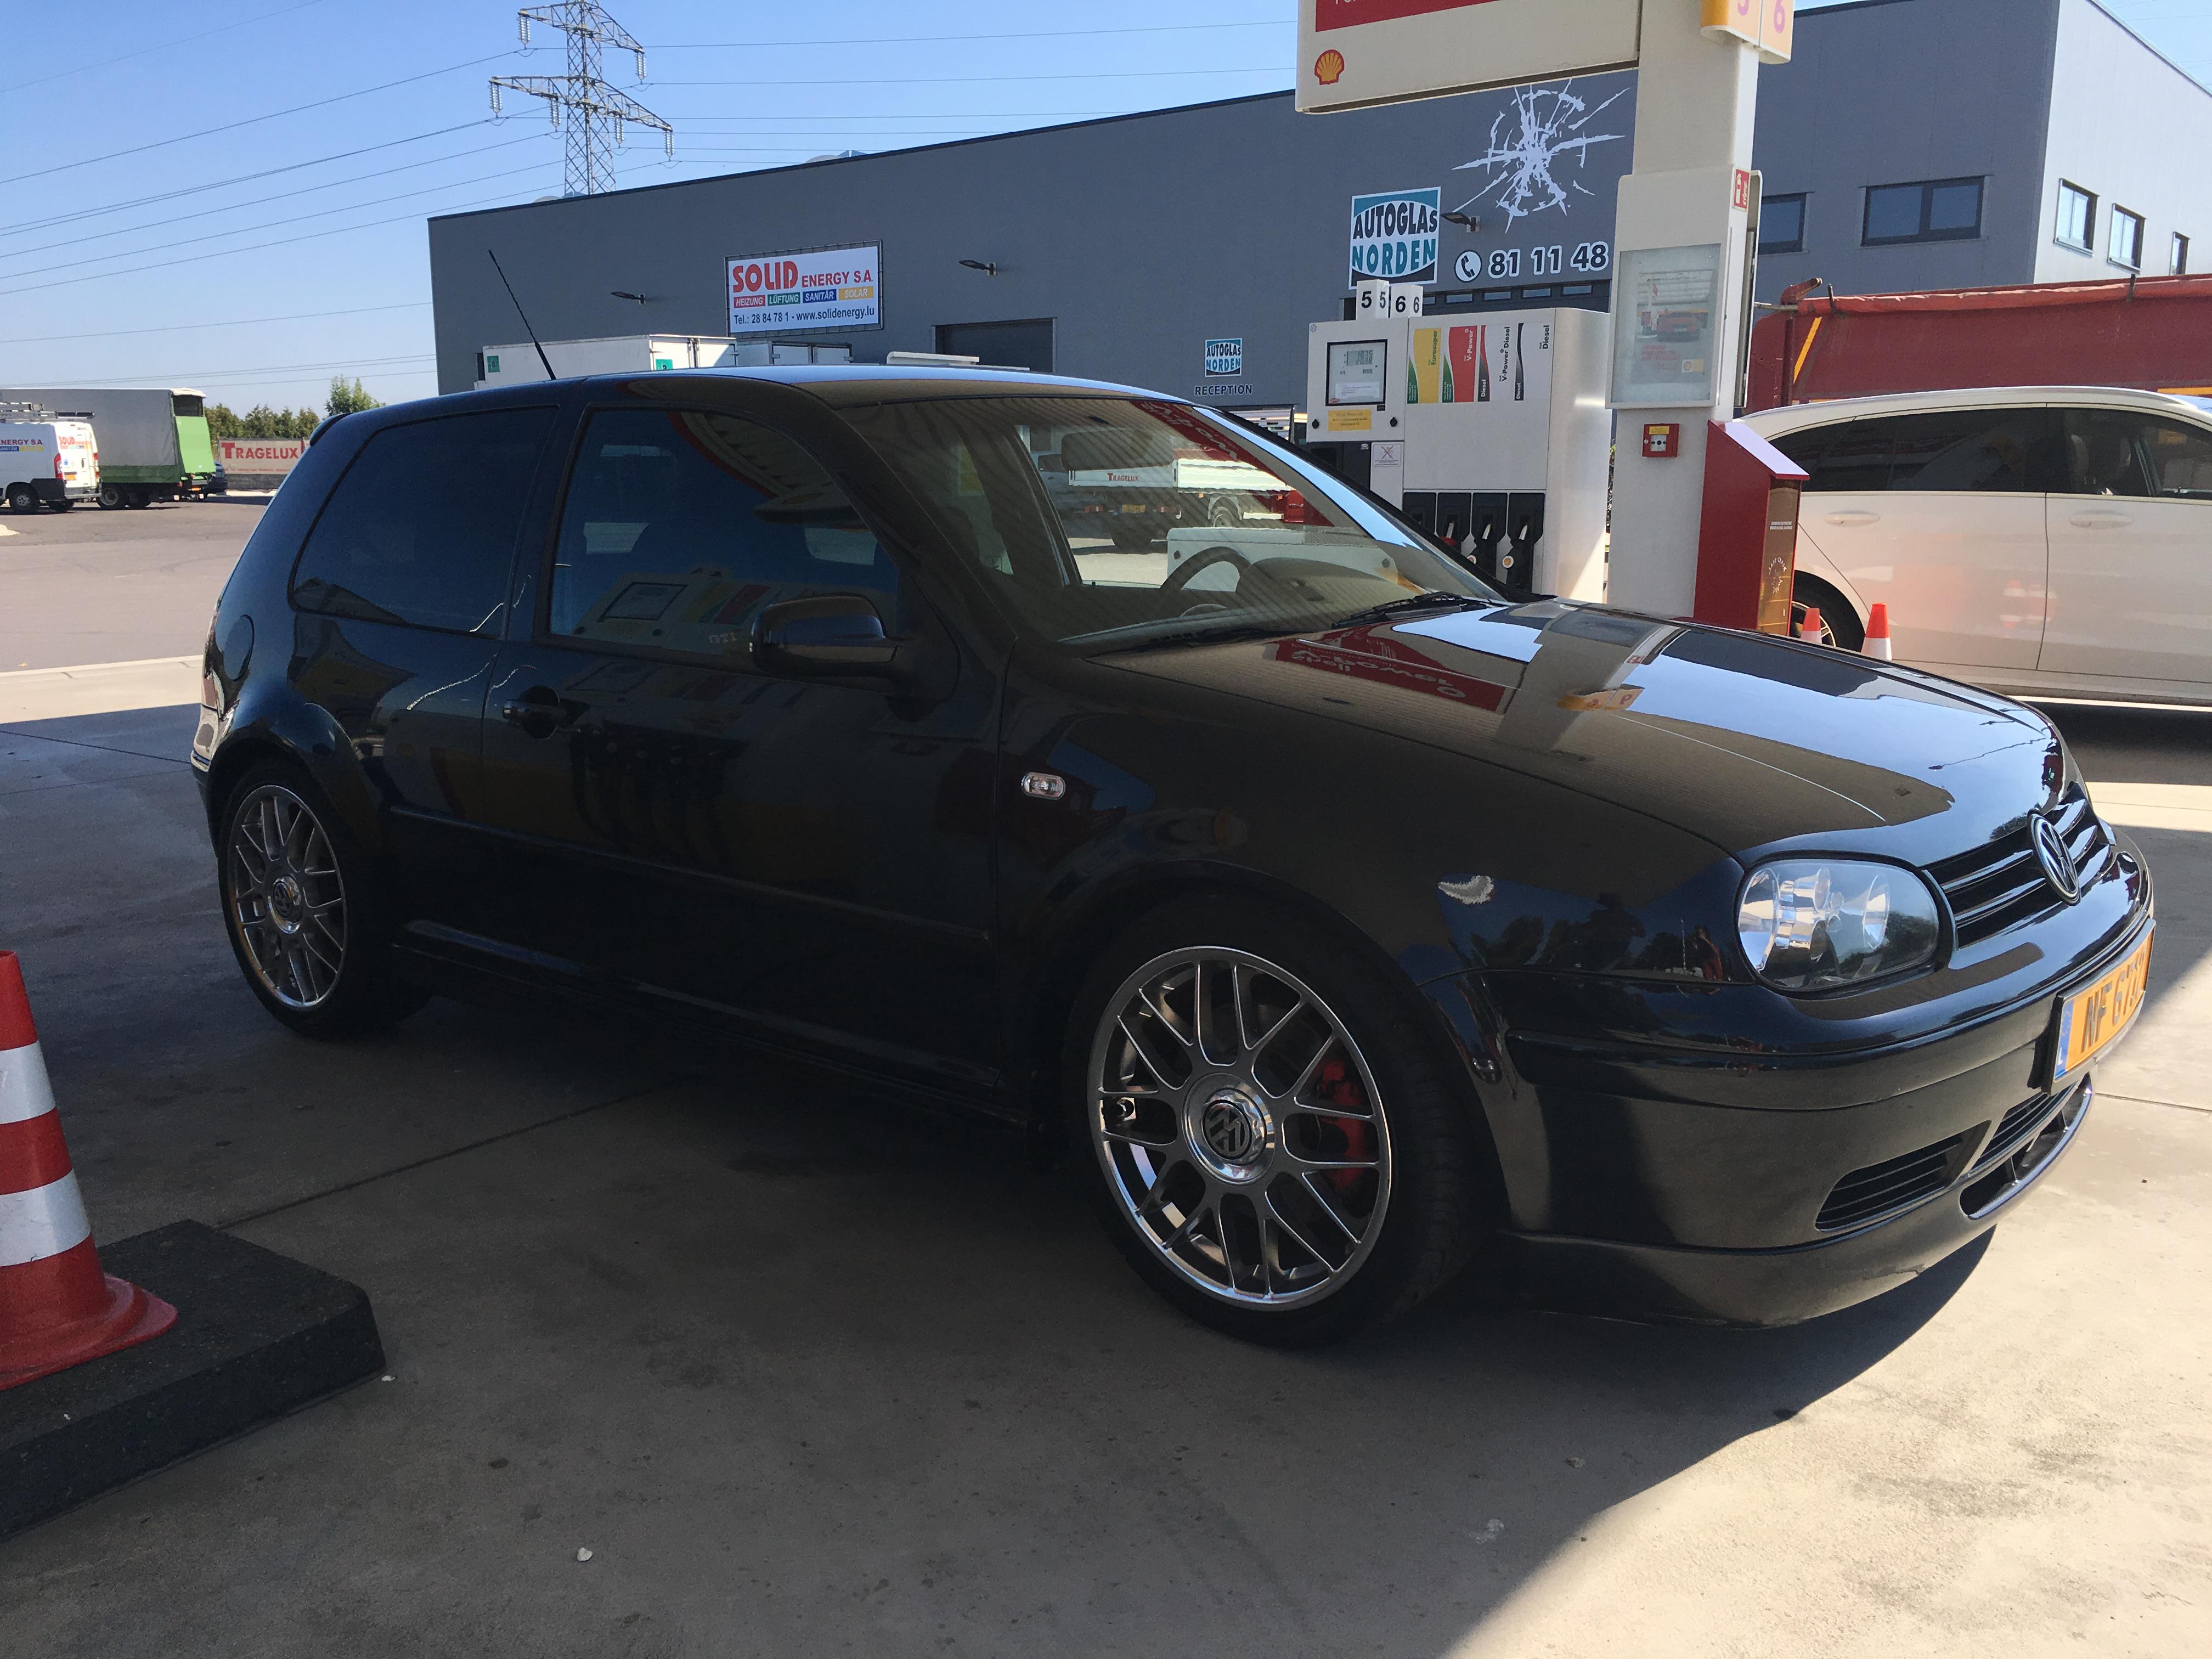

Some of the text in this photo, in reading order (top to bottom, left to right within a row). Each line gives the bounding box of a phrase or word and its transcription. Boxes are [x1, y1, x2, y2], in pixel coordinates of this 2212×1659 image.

[1352, 202, 1438, 240] AUTOGLAS
[1352, 238, 1436, 275] NORDEN
[1489, 242, 1609, 278] 81 11 48
[732, 261, 799, 293] SOLID
[802, 271, 850, 288] ENERGY
[736, 288, 868, 307] HEIZUNG LÜFTUNG SANITÄR SOLAR
[1361, 291, 1372, 308] 5
[1379, 291, 1386, 309] 5
[1395, 295, 1406, 312] 6
[1413, 296, 1419, 313] 6
[733, 315, 749, 325] Tel.:
[752, 314, 760, 324] 28
[762, 313, 771, 323] 84
[774, 312, 782, 322] 78
[785, 312, 789, 321] 1
[796, 306, 874, 321] www.solidenergy.lu
[1206, 343, 1241, 357] AUTOGLAS
[1206, 358, 1241, 372] NORDEN
[1194, 384, 1252, 396] RECEPTION
[221, 442, 298, 459] TRAGELUX
[1107, 472, 1139, 482] TRAGELUX
[2080, 980, 2112, 1054] NF
